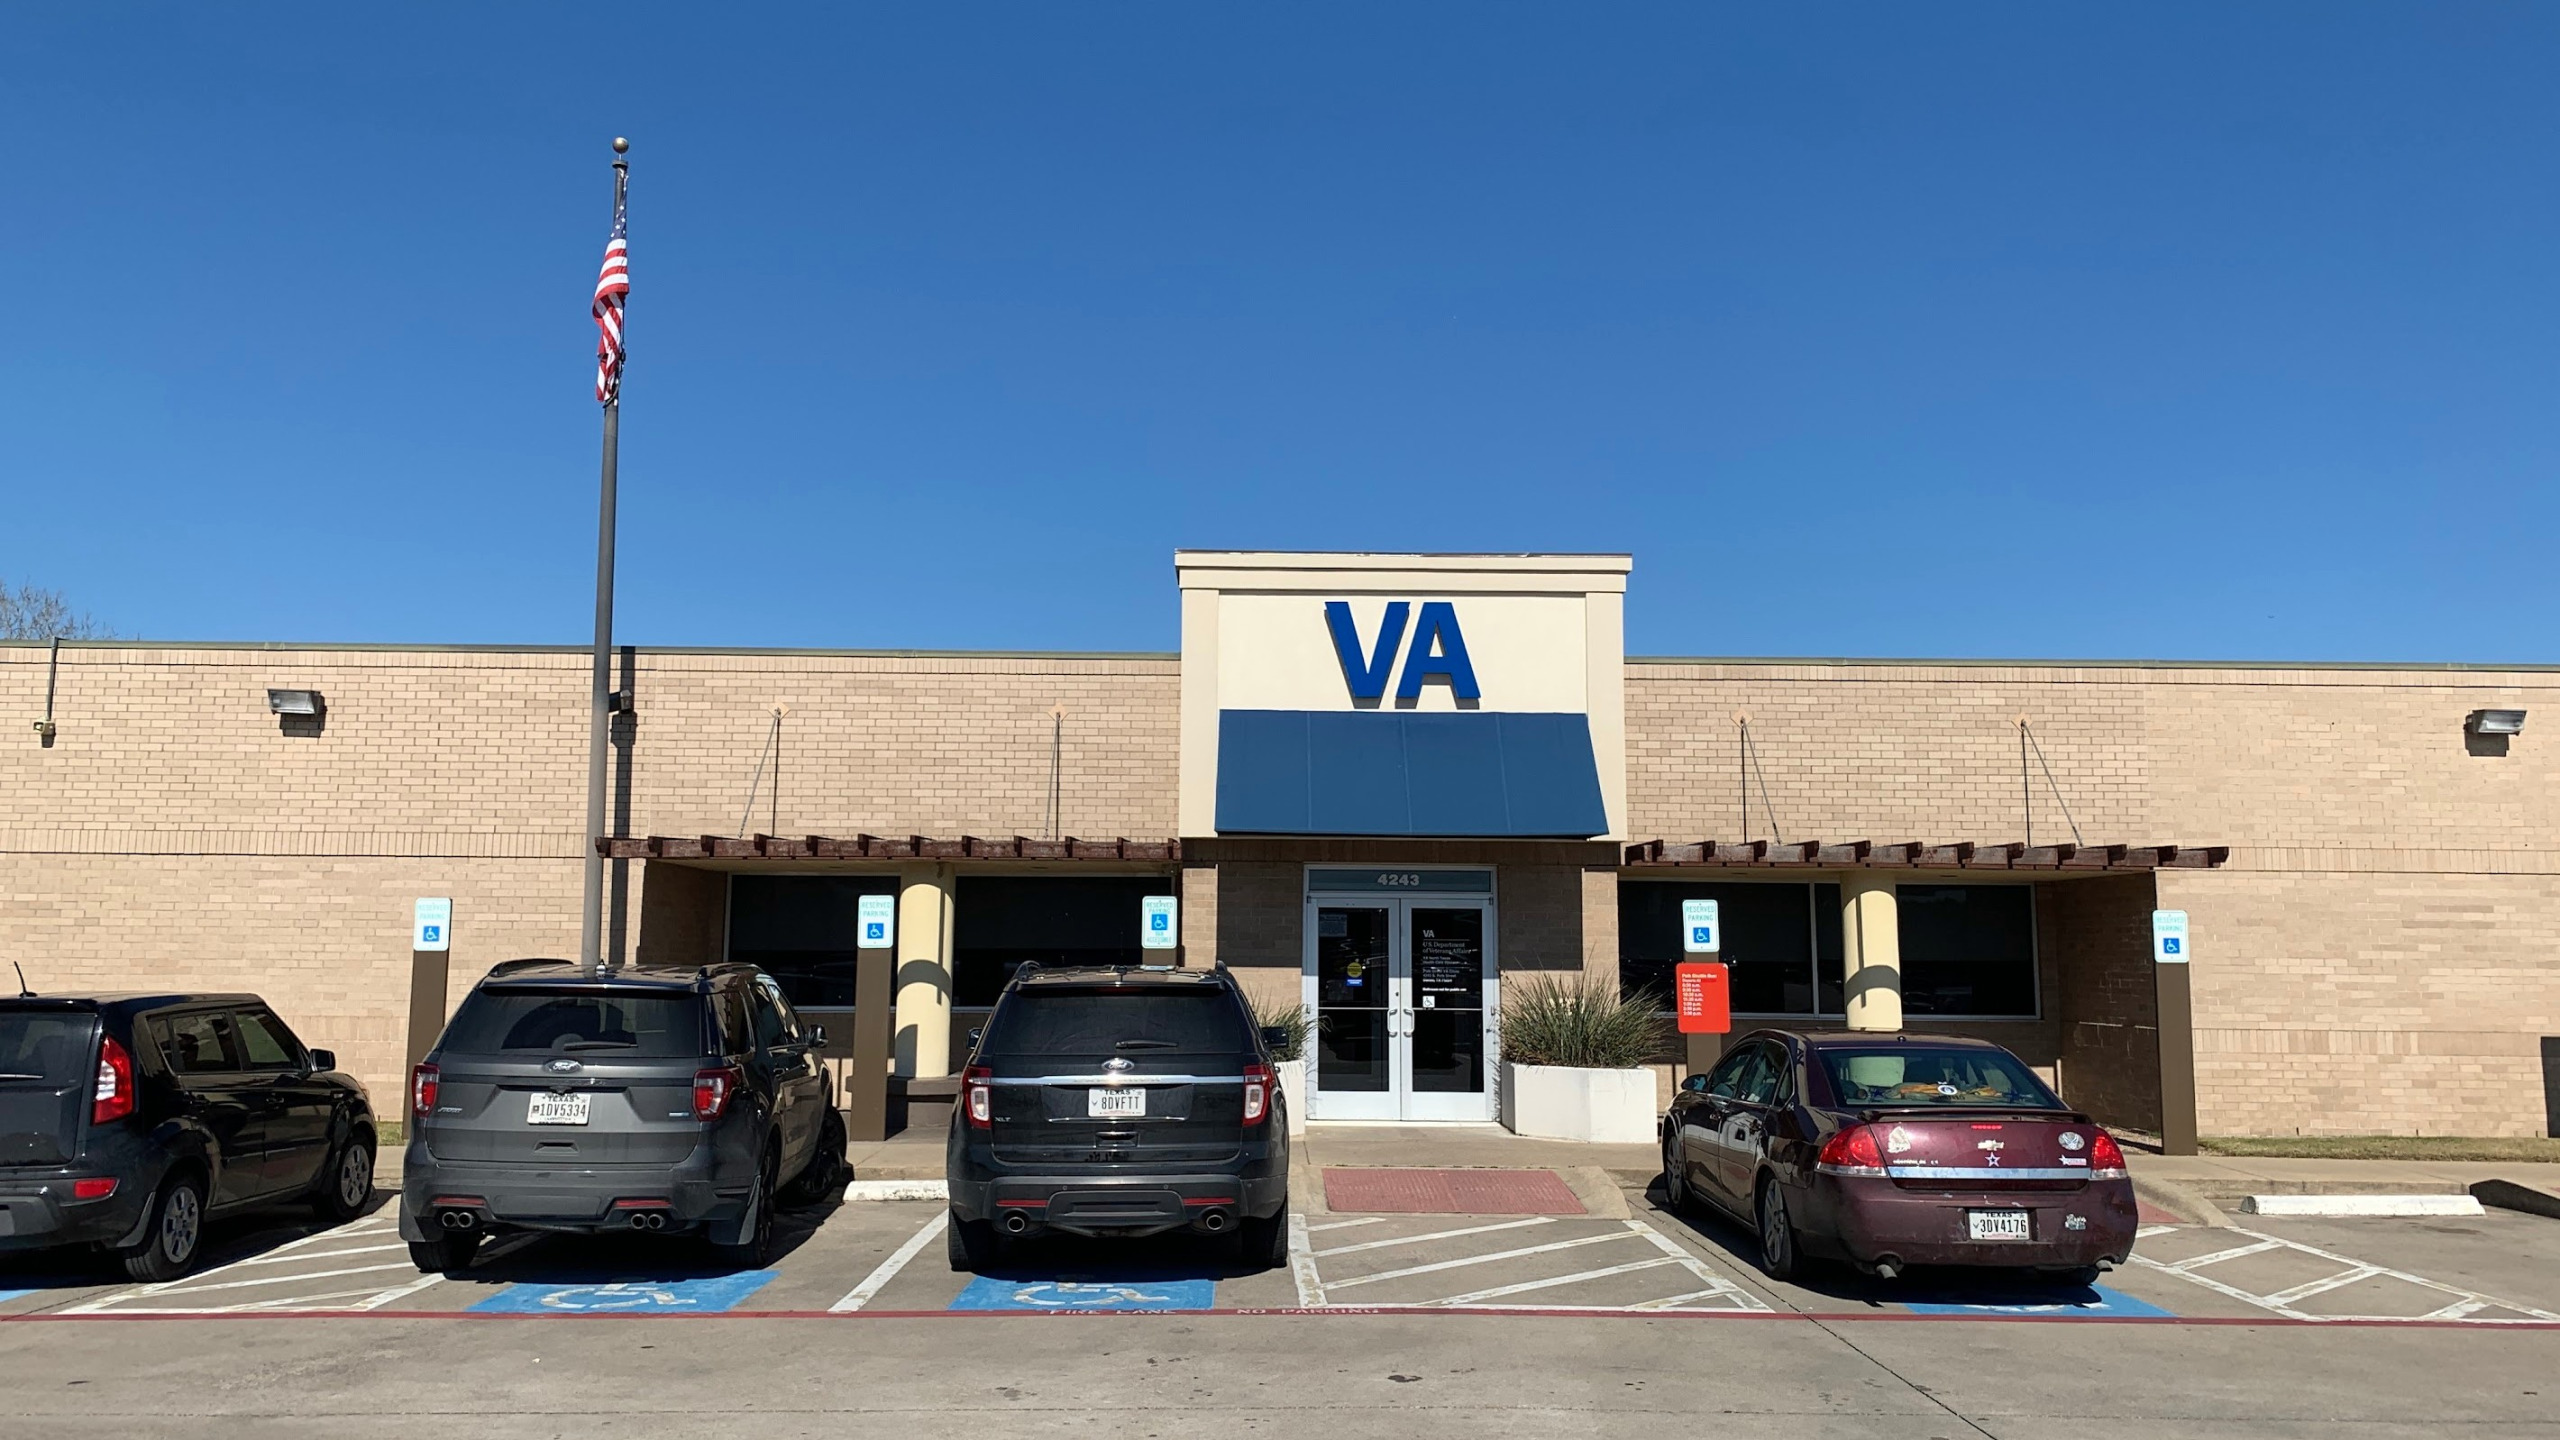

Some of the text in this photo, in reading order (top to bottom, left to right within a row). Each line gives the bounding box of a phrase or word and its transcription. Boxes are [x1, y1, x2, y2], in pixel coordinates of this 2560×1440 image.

[1324, 601, 1481, 700] VA
[1377, 873, 1419, 886] 4243
[862, 901, 891, 909] RESERVED
[1685, 905, 1715, 913] RESERVED
[1422, 929, 1435, 938] VA
[1101, 1096, 1139, 1110] 8DVFTT
[540, 1103, 586, 1117] 1DV5334
[1979, 1219, 2027, 1233] 3DV4176
